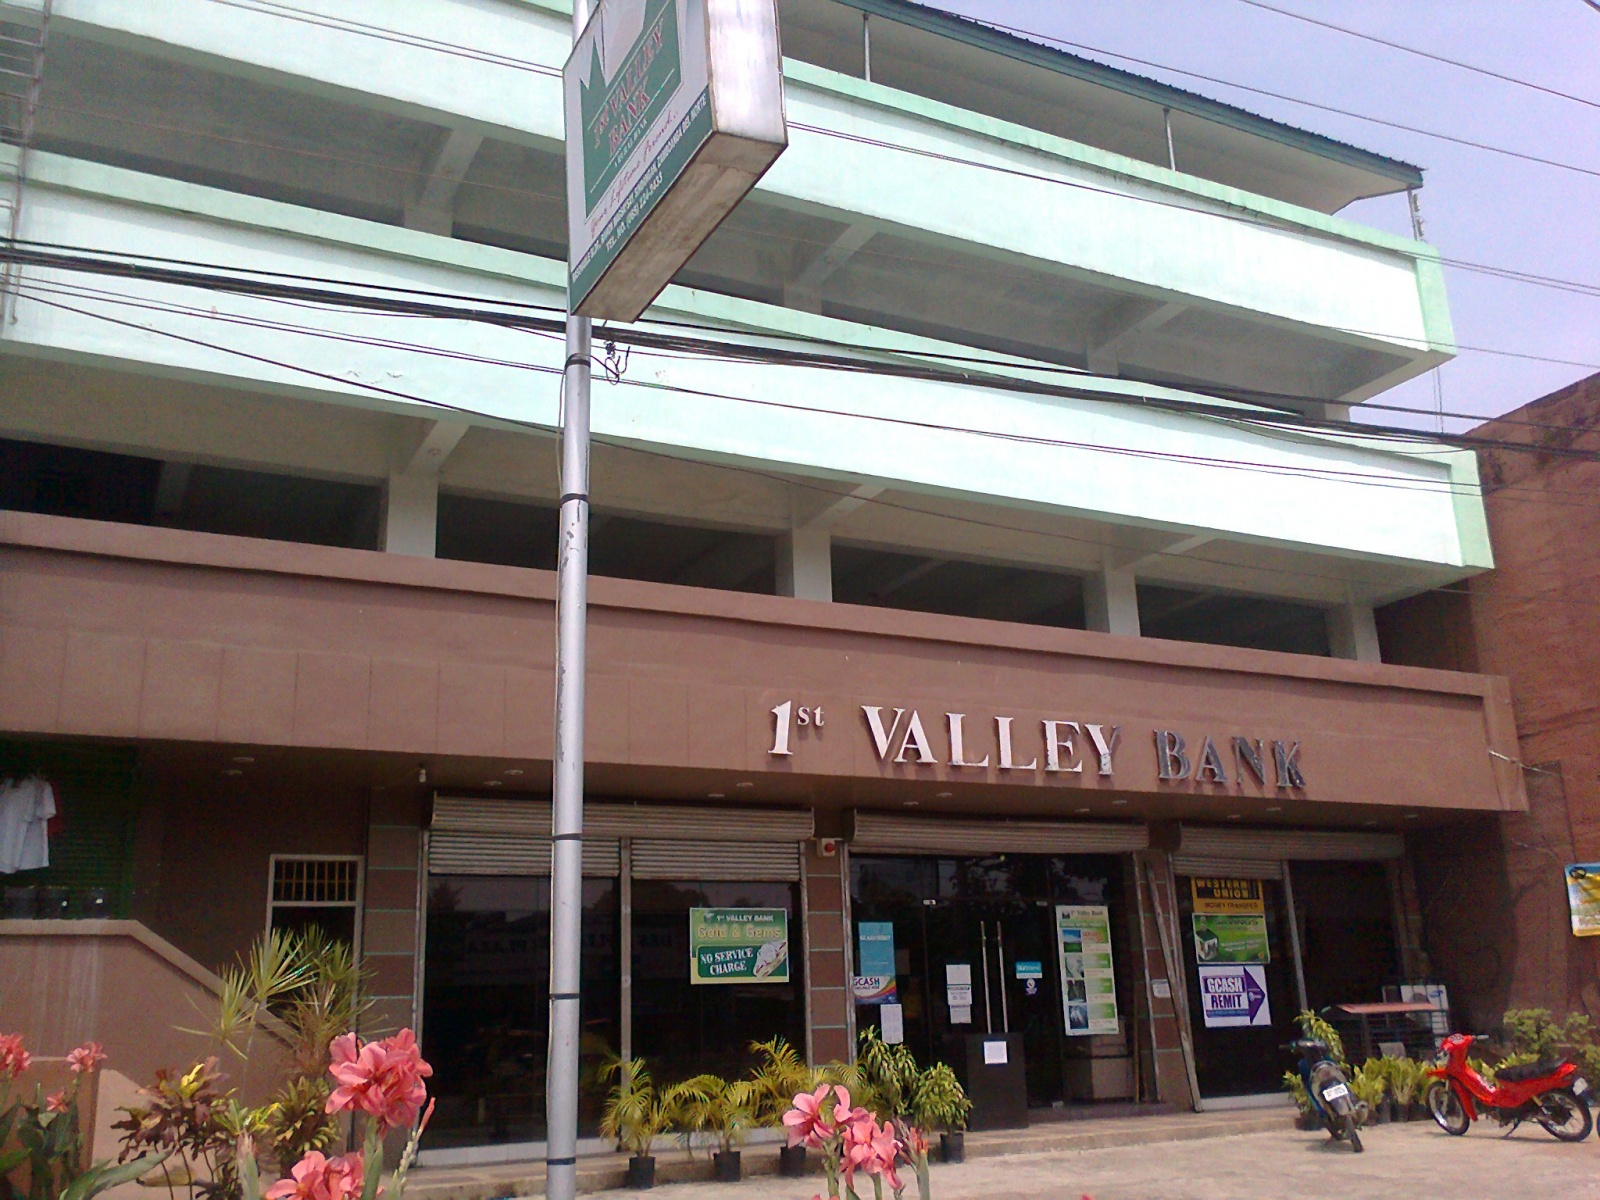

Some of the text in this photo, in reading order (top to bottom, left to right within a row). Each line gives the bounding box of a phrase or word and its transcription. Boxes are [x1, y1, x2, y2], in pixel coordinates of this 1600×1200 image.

[609, 17, 664, 118] VALLEY
[609, 75, 650, 157] BANK
[768, 699, 1306, 790] 1st VALLEY BANK
[1213, 888, 1250, 898] UNION
[725, 914, 753, 922] VALLEY
[753, 914, 774, 922] BANK
[697, 923, 782, 940] Gold & Gems
[700, 947, 754, 965] NO SERVICE
[709, 960, 747, 976] CHARGE
[1206, 977, 1244, 993] GCASH
[1210, 994, 1242, 1009] REMIT
